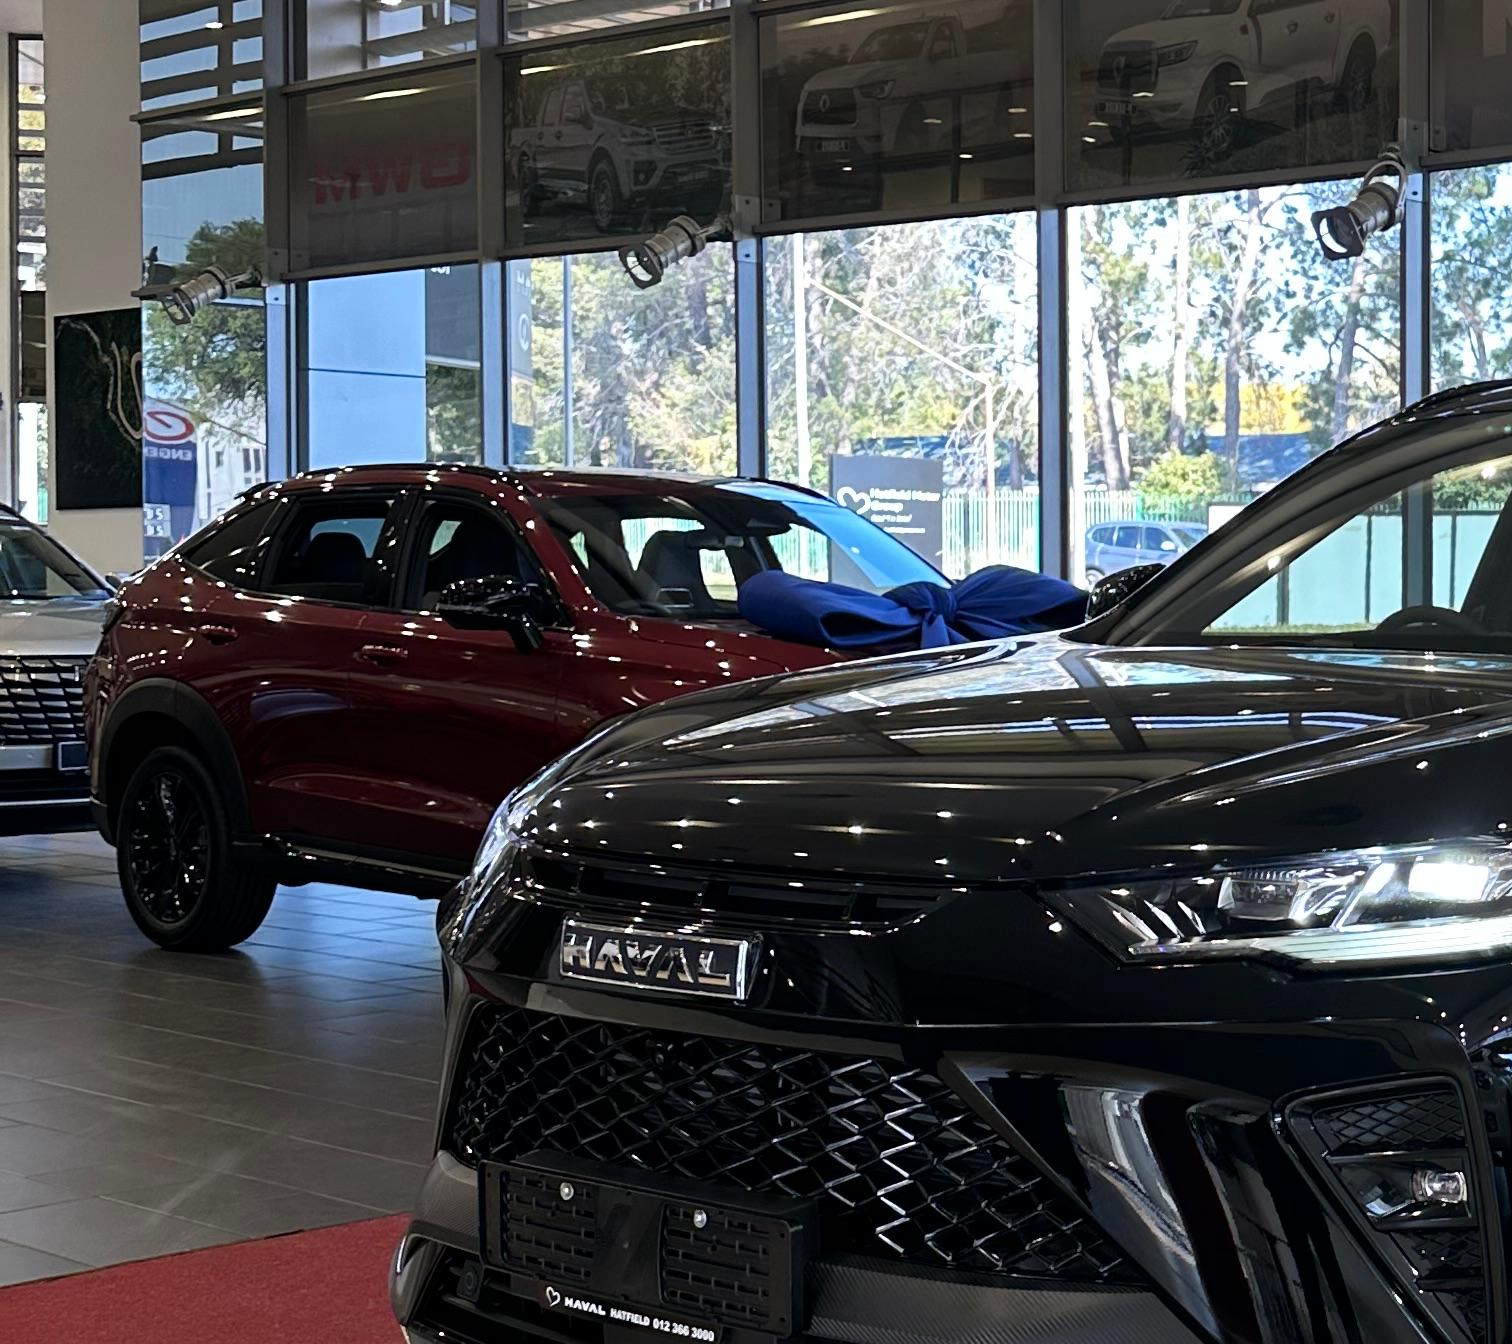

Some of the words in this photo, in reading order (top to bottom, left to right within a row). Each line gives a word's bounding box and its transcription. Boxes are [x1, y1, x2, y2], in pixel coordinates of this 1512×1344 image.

[563, 932, 731, 987] HAVAL
[564, 1296, 606, 1316] HAVAL
[609, 1308, 651, 1327] HATFIELD
[652, 1318, 671, 1332] 012
